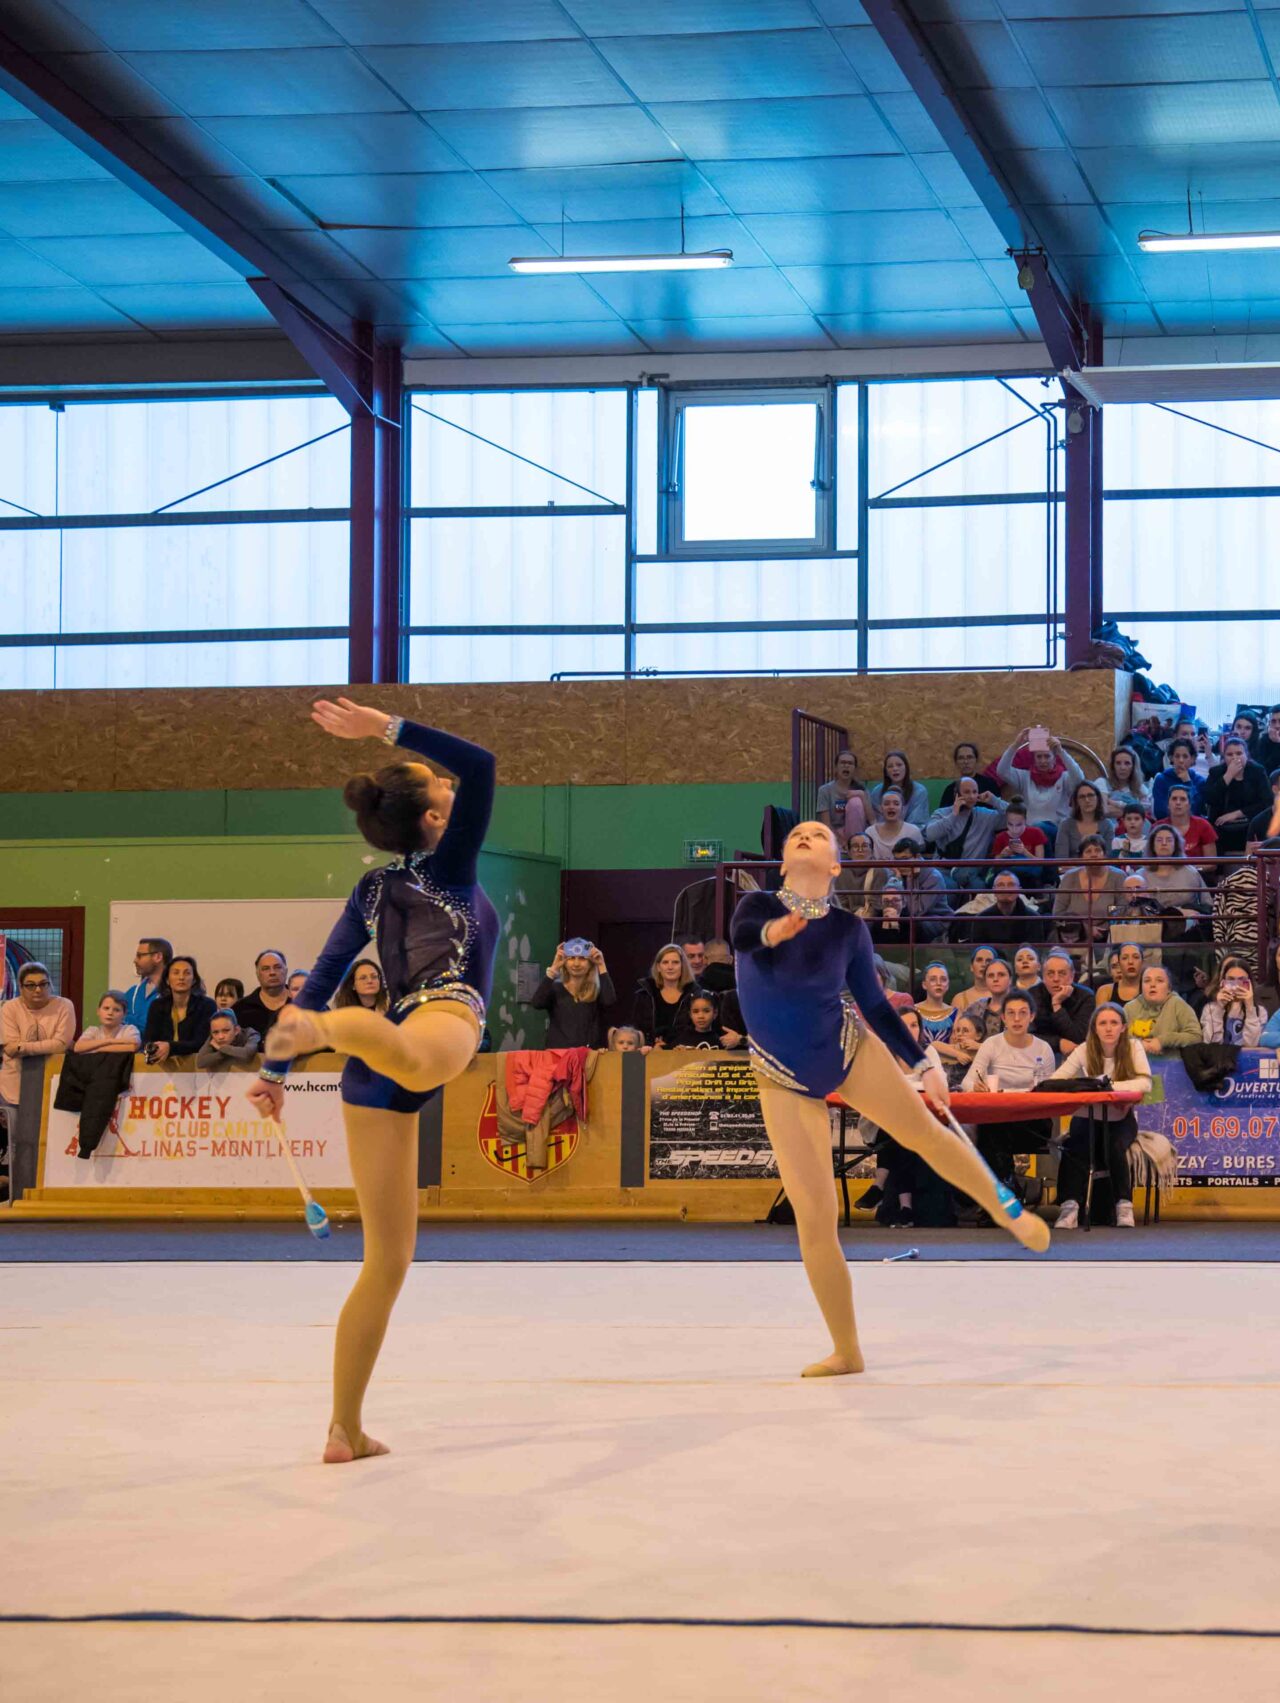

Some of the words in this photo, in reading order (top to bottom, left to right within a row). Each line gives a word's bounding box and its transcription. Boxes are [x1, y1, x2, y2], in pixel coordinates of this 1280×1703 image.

[129, 1096, 231, 1119] HOCKEY
[165, 1121, 210, 1138] CLUB
[1223, 1155, 1275, 1169] BURES
[1208, 1177, 1259, 1186] PORTAILS
